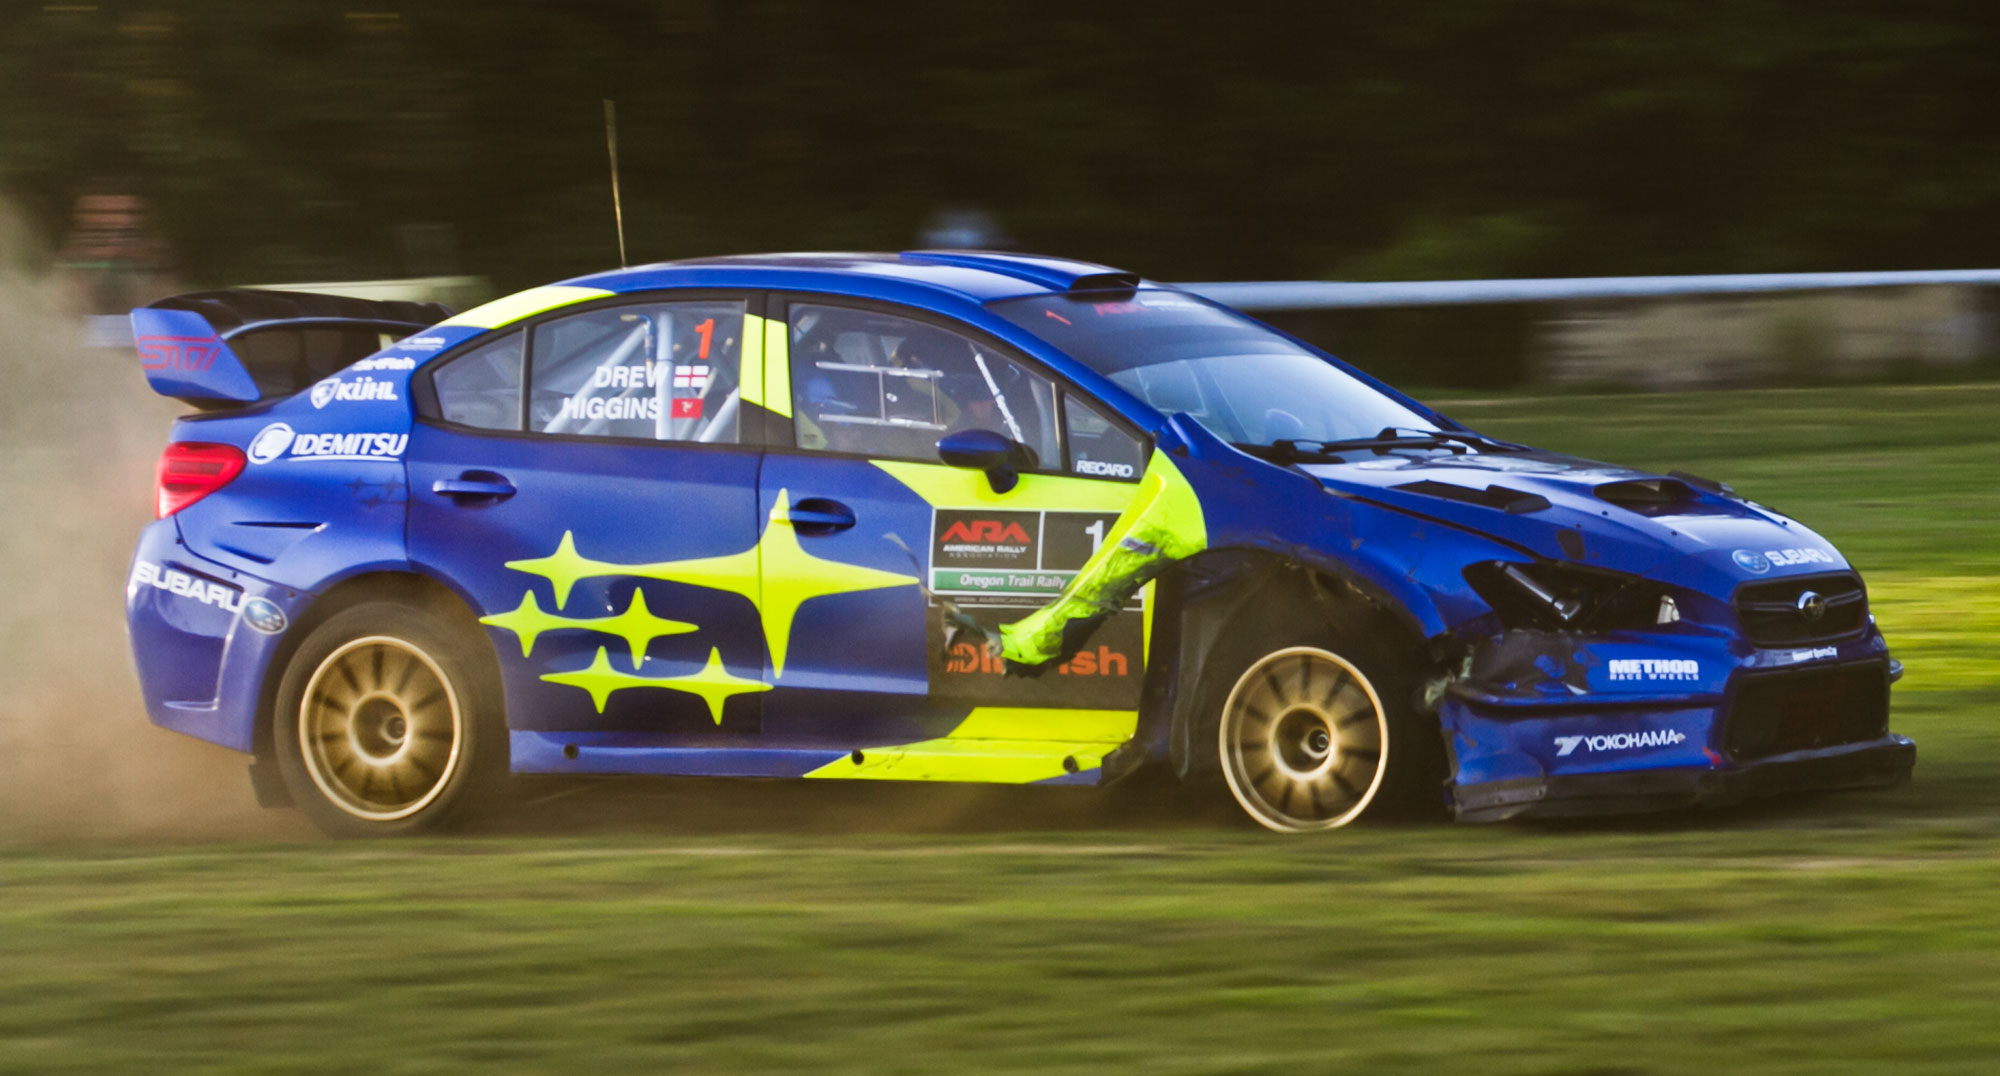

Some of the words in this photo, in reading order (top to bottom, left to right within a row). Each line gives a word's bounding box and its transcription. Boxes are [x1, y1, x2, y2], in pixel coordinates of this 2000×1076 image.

[695, 318, 715, 359] 1
[594, 365, 670, 388] DREW
[335, 376, 398, 401] KÜHL
[563, 397, 662, 420] HIGGINS
[291, 433, 409, 456] IDEMITSU
[1076, 460, 1135, 478] RECARO
[941, 520, 1032, 543] ARA
[943, 544, 995, 553] AMERICAN
[997, 545, 1028, 554] RALLY
[1766, 548, 1833, 567] SUBARU
[134, 560, 249, 615] SUBARU
[960, 574, 1004, 589] Oregon
[1008, 575, 1035, 588] Trail
[1037, 576, 1067, 591] Rally
[1609, 659, 1699, 674] METHOD
[1584, 729, 1679, 752] YOKOHAMA
